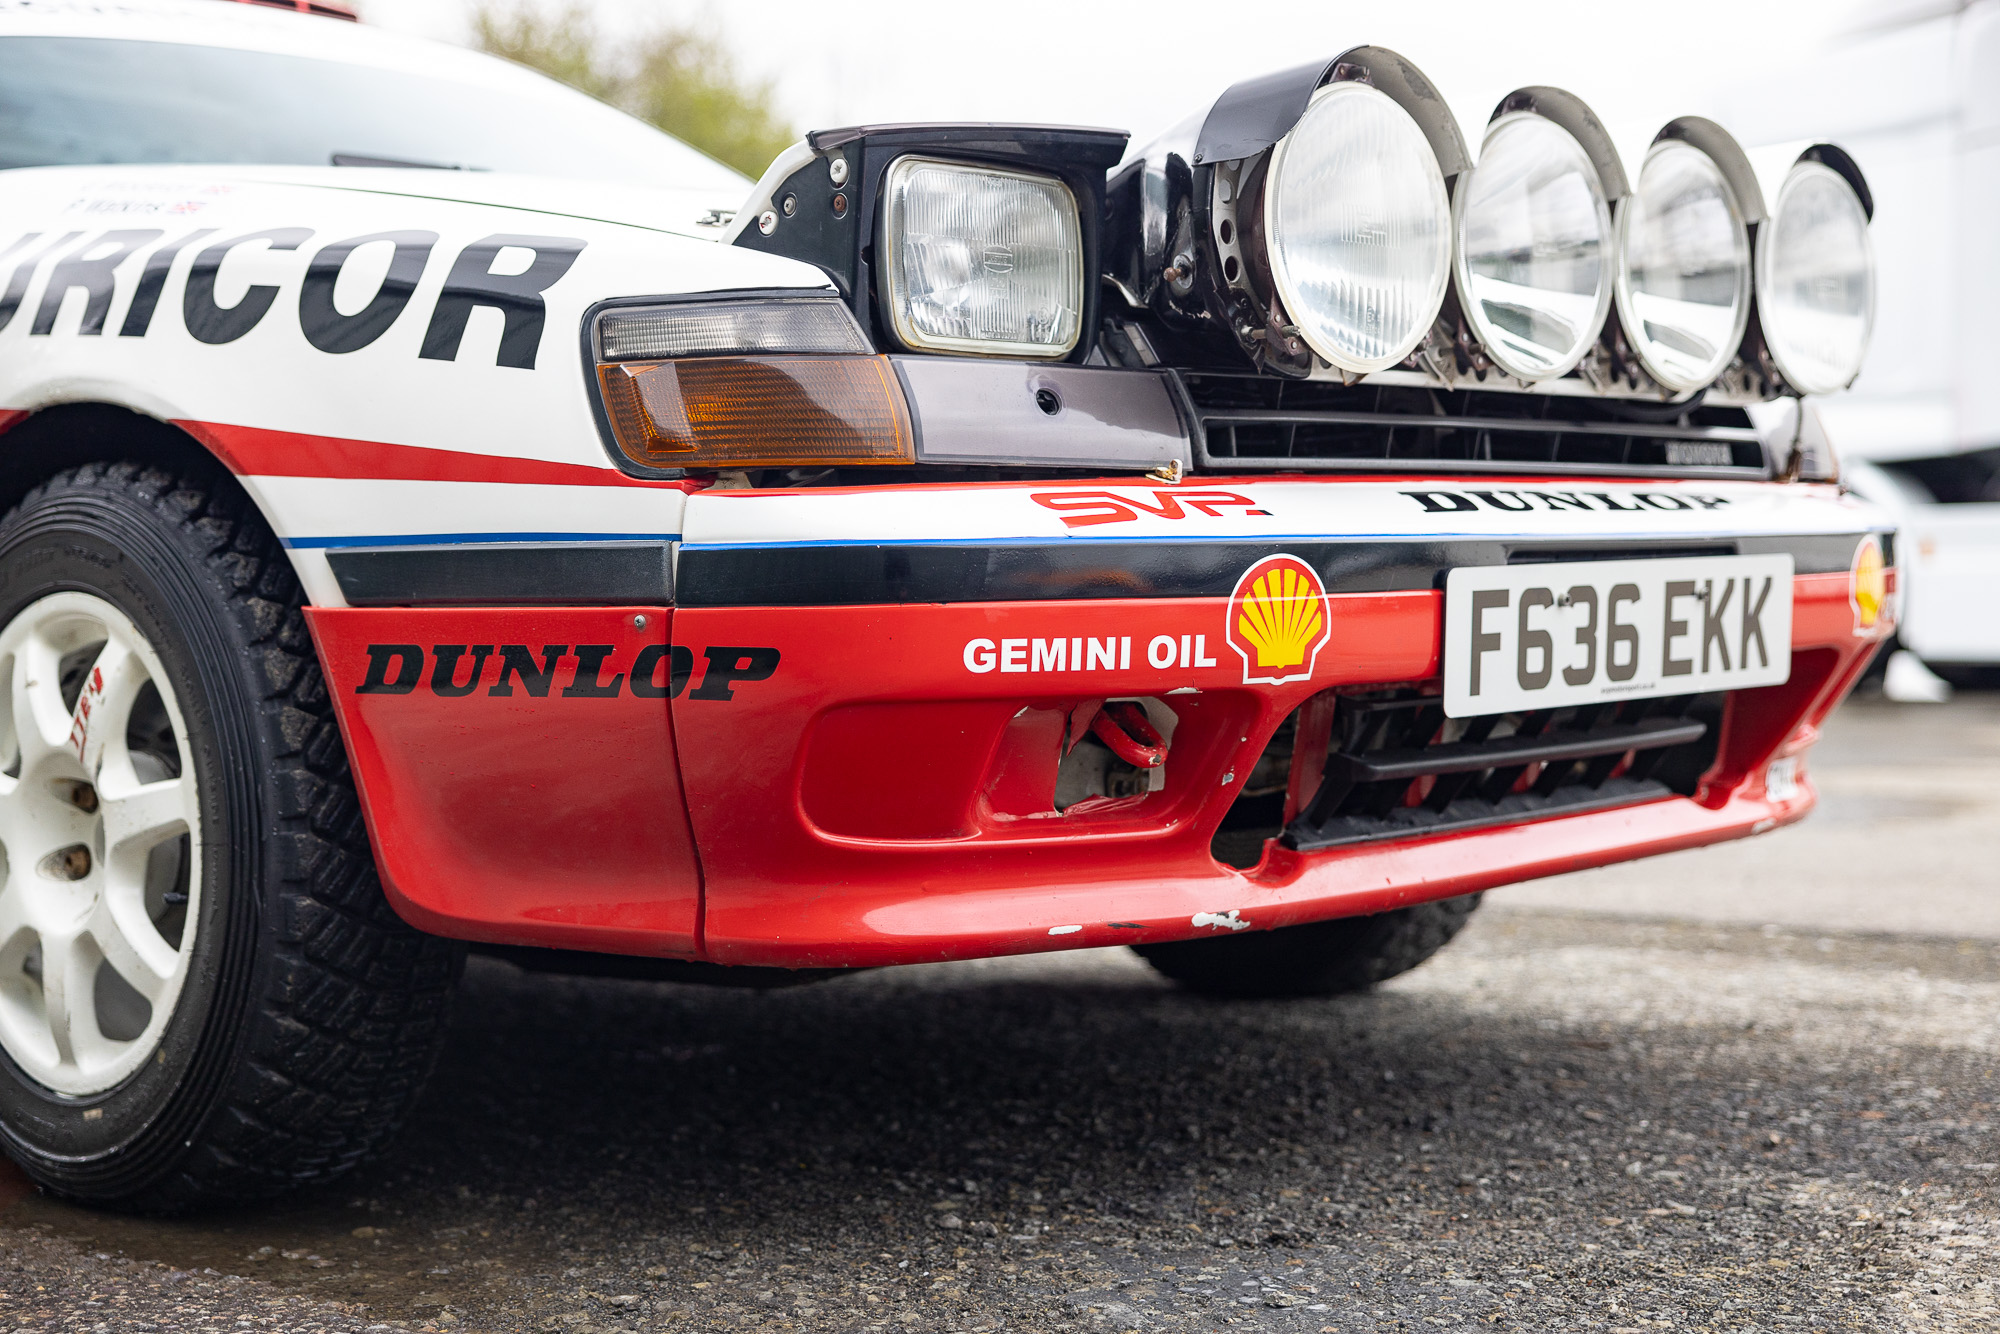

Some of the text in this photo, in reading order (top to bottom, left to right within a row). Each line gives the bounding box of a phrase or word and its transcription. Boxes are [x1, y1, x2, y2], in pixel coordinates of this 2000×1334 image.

[1398, 490, 1730, 513] DUNLOP
[962, 635, 1217, 674] GEMINI OIL
[1470, 577, 1772, 697] F636 EKK
[355, 644, 782, 701] DUNLOP
